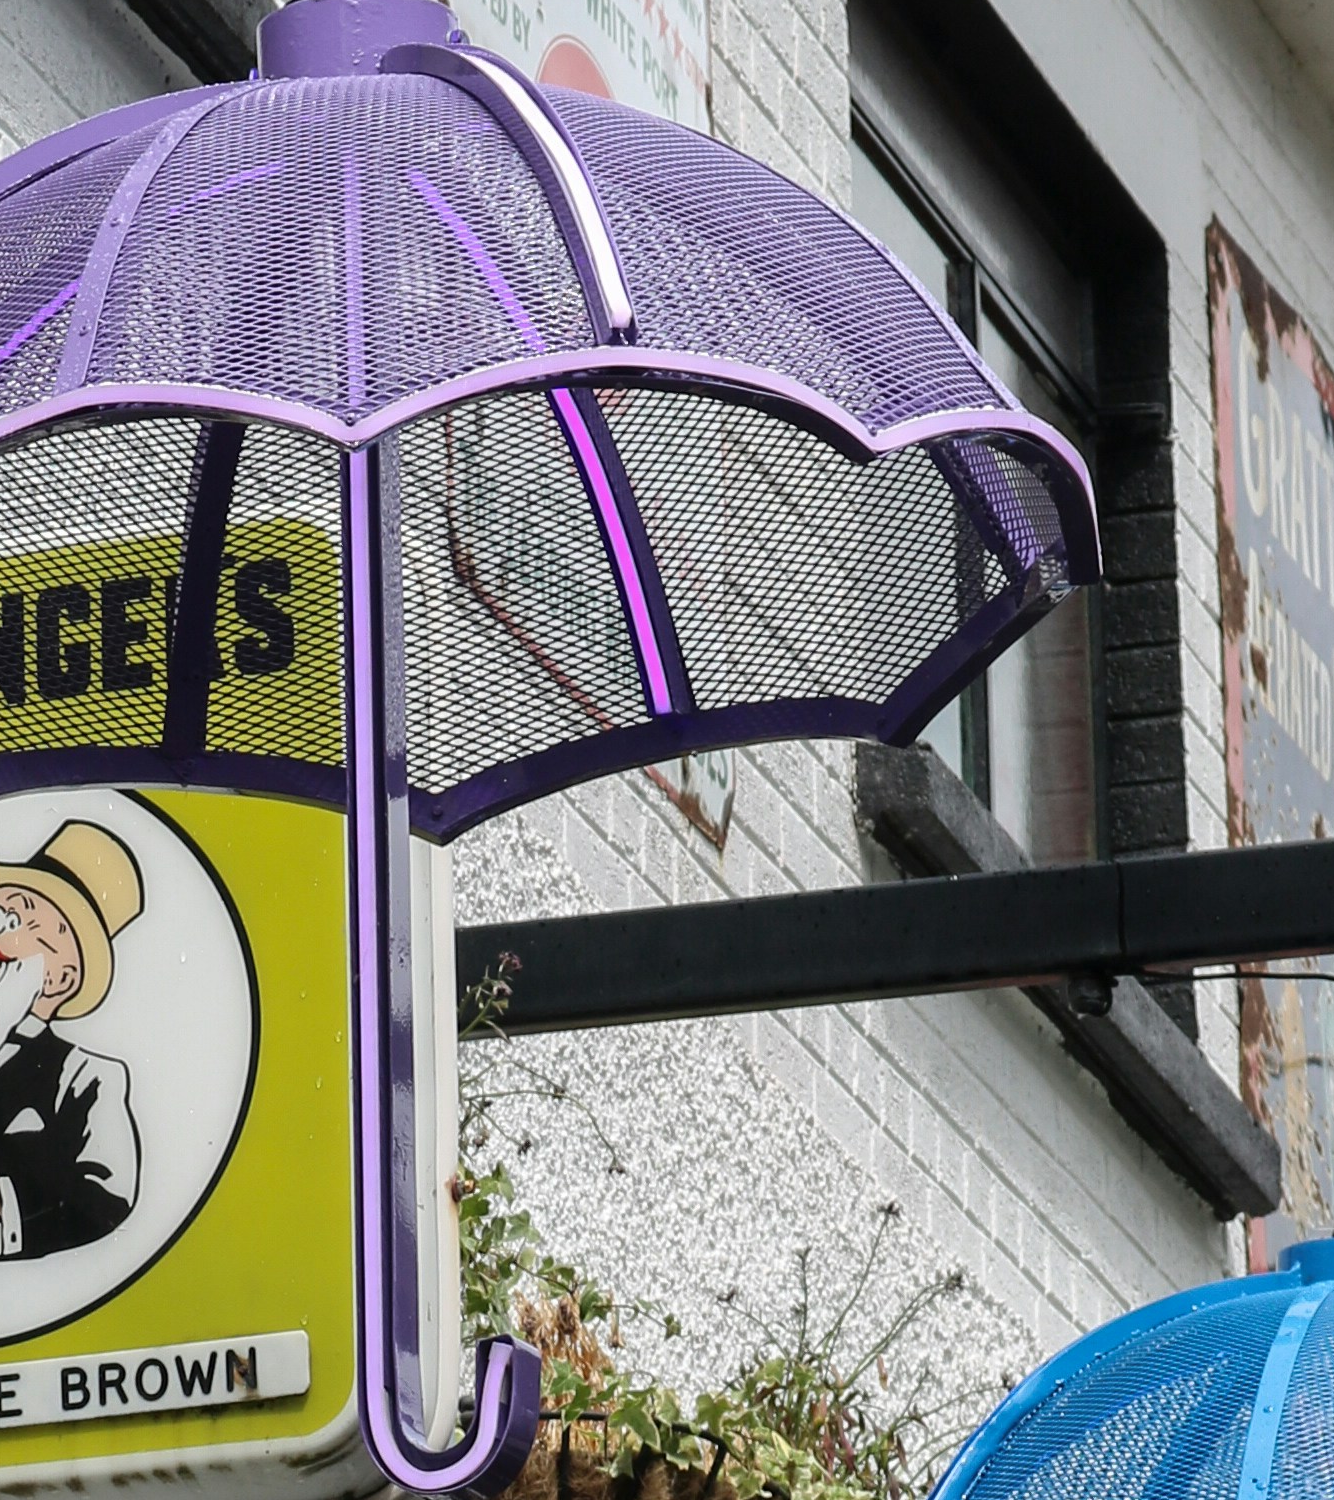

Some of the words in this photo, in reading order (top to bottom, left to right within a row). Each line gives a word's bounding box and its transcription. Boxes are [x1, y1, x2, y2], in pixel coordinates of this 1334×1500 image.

[510, 0, 532, 52] BY
[642, 38, 679, 118] PORT
[61, 1345, 260, 1407] BROWN
